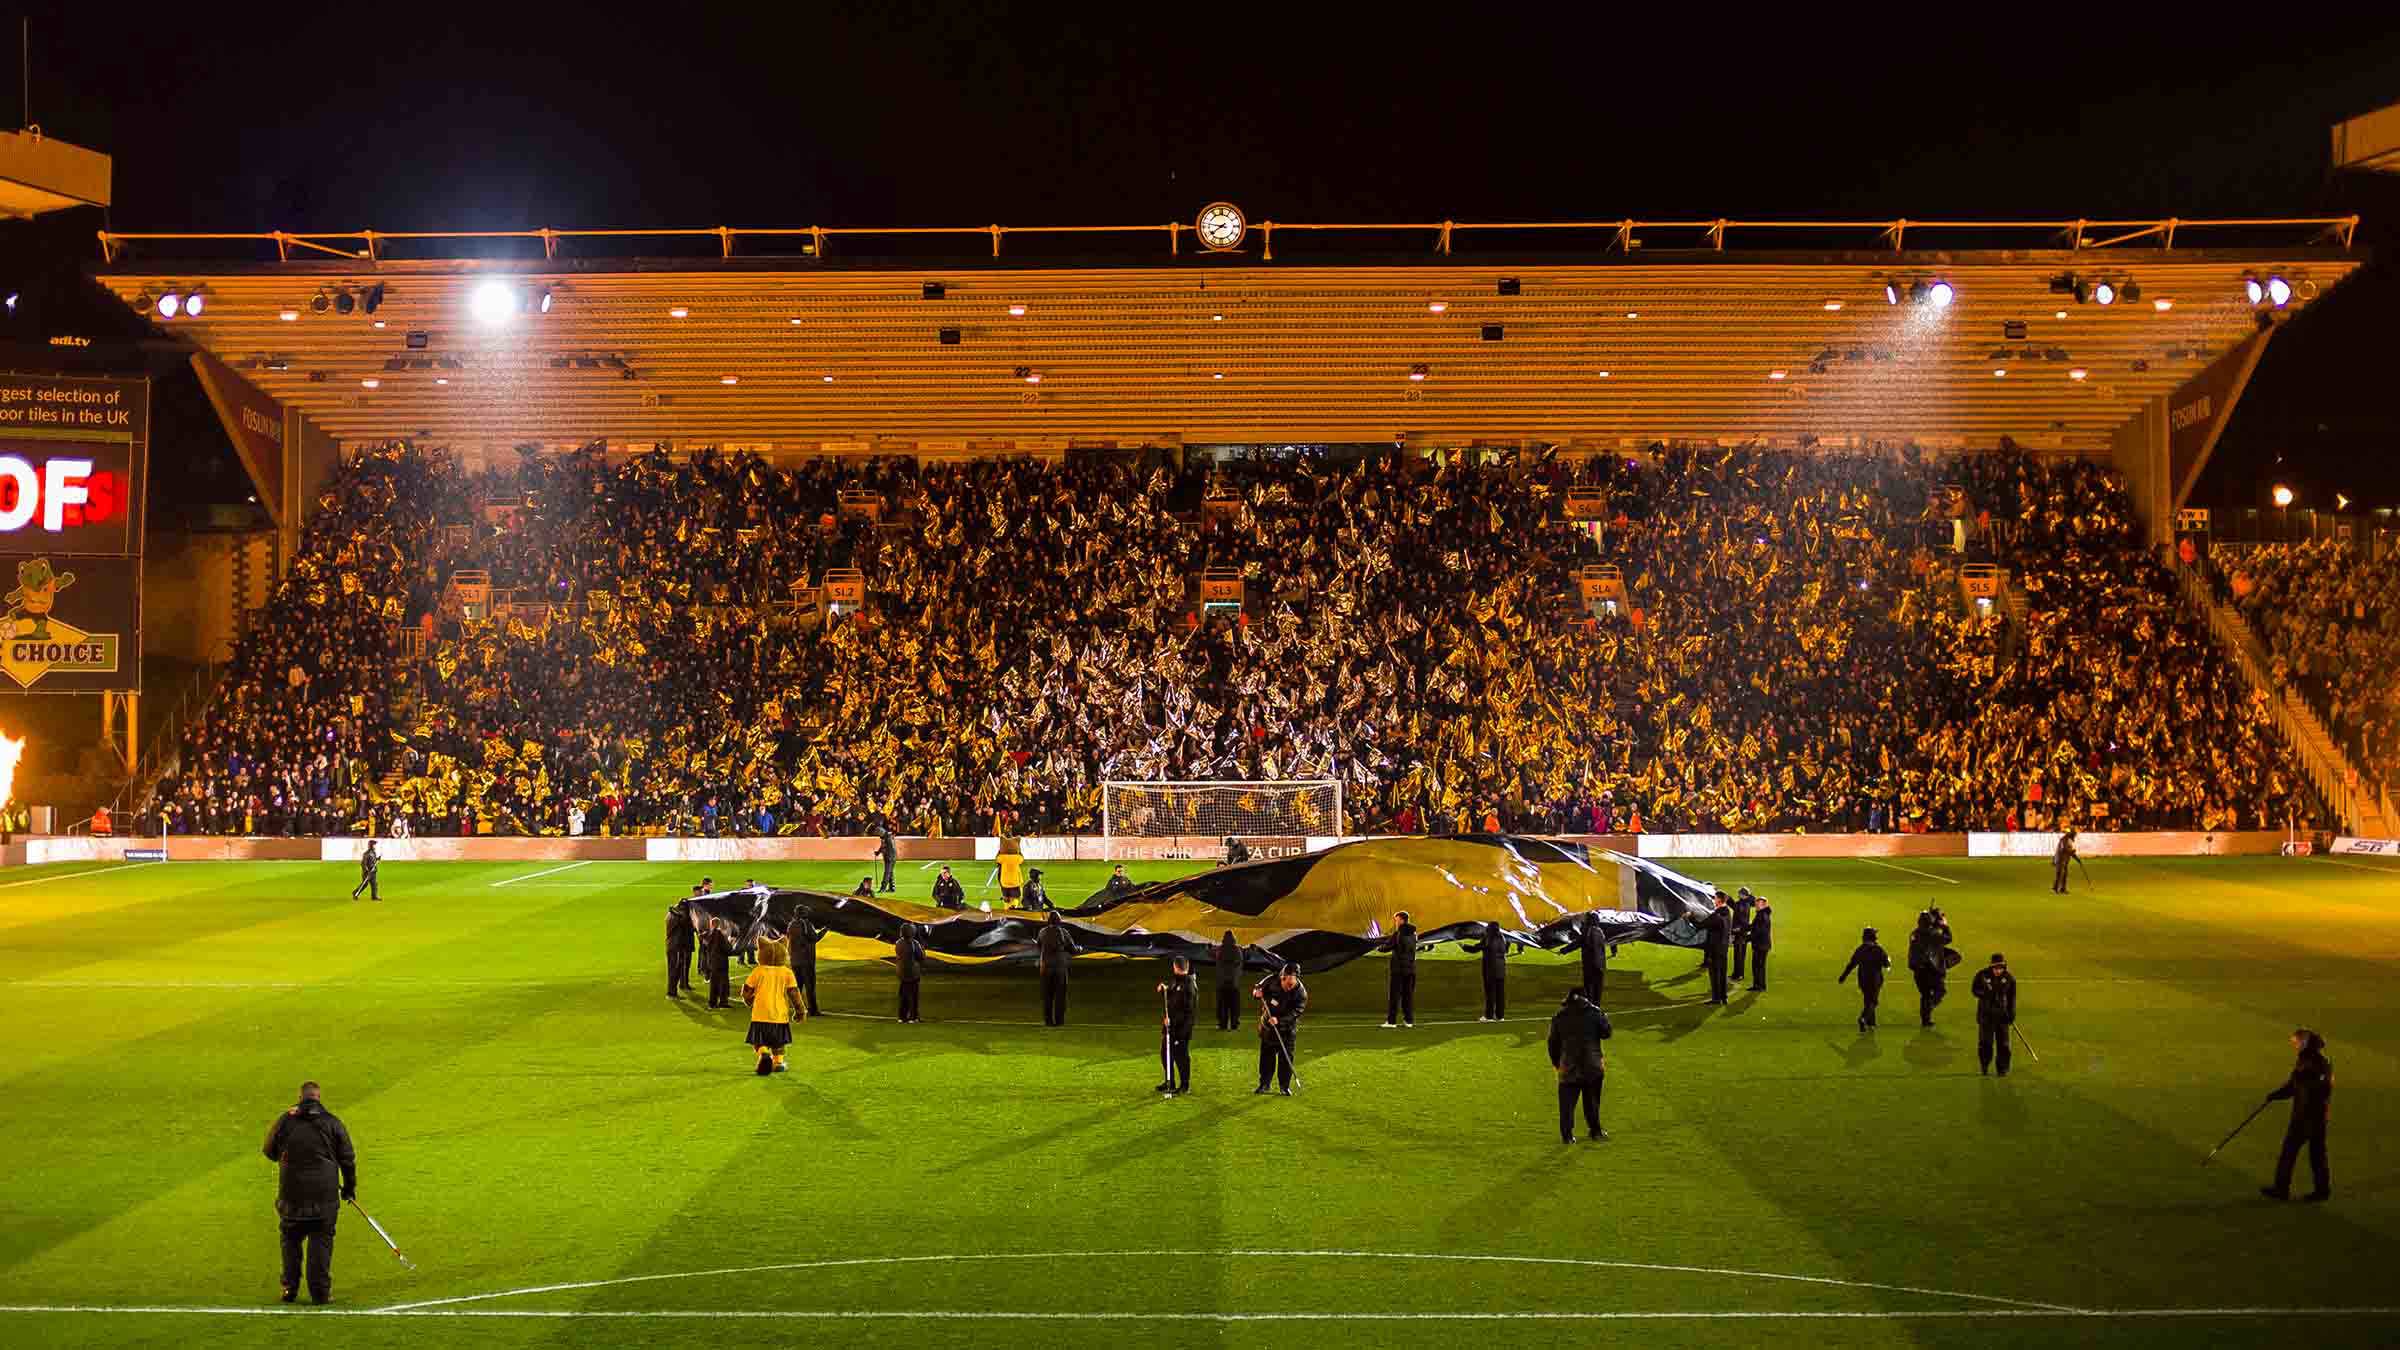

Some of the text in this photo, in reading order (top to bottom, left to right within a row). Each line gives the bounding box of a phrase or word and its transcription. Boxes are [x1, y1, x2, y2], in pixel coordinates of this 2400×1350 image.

[36, 387, 101, 402] selection
[104, 390, 120, 404] of
[29, 408, 58, 421] tiles
[62, 408, 75, 422] in
[80, 409, 103, 423] the
[107, 410, 129, 425] UK
[834, 587, 855, 597] SL2
[1212, 585, 1232, 596] SL3
[1591, 584, 1611, 594] SL4
[13, 642, 104, 664] CHOICE
[1268, 846, 1301, 858] CUP
